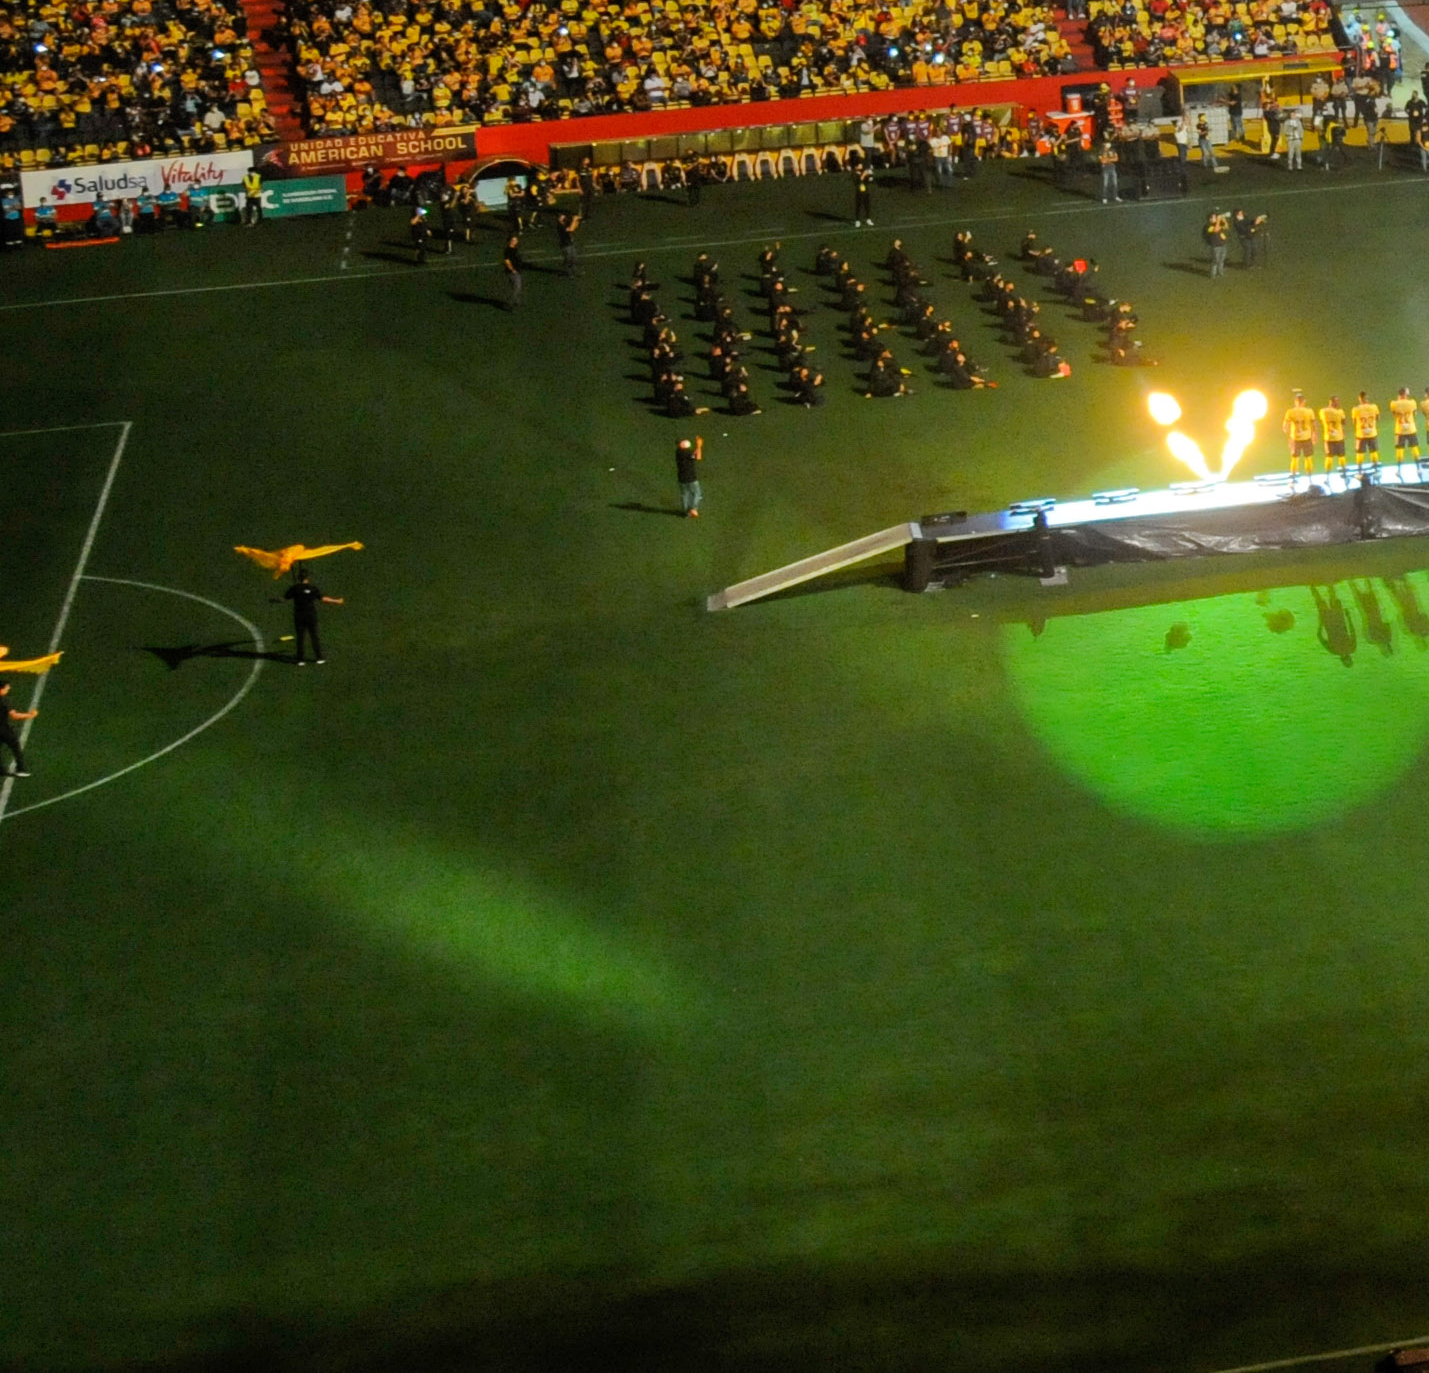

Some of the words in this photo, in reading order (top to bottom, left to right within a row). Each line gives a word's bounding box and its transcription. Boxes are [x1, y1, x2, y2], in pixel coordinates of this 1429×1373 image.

[288, 146, 383, 164] AMERICAN
[397, 137, 467, 155] SCHOOL
[290, 139, 343, 151] UNIDAD
[350, 131, 426, 146] EDUCATIVA
[75, 174, 147, 193] Saludsa
[161, 160, 228, 185] Vitality
